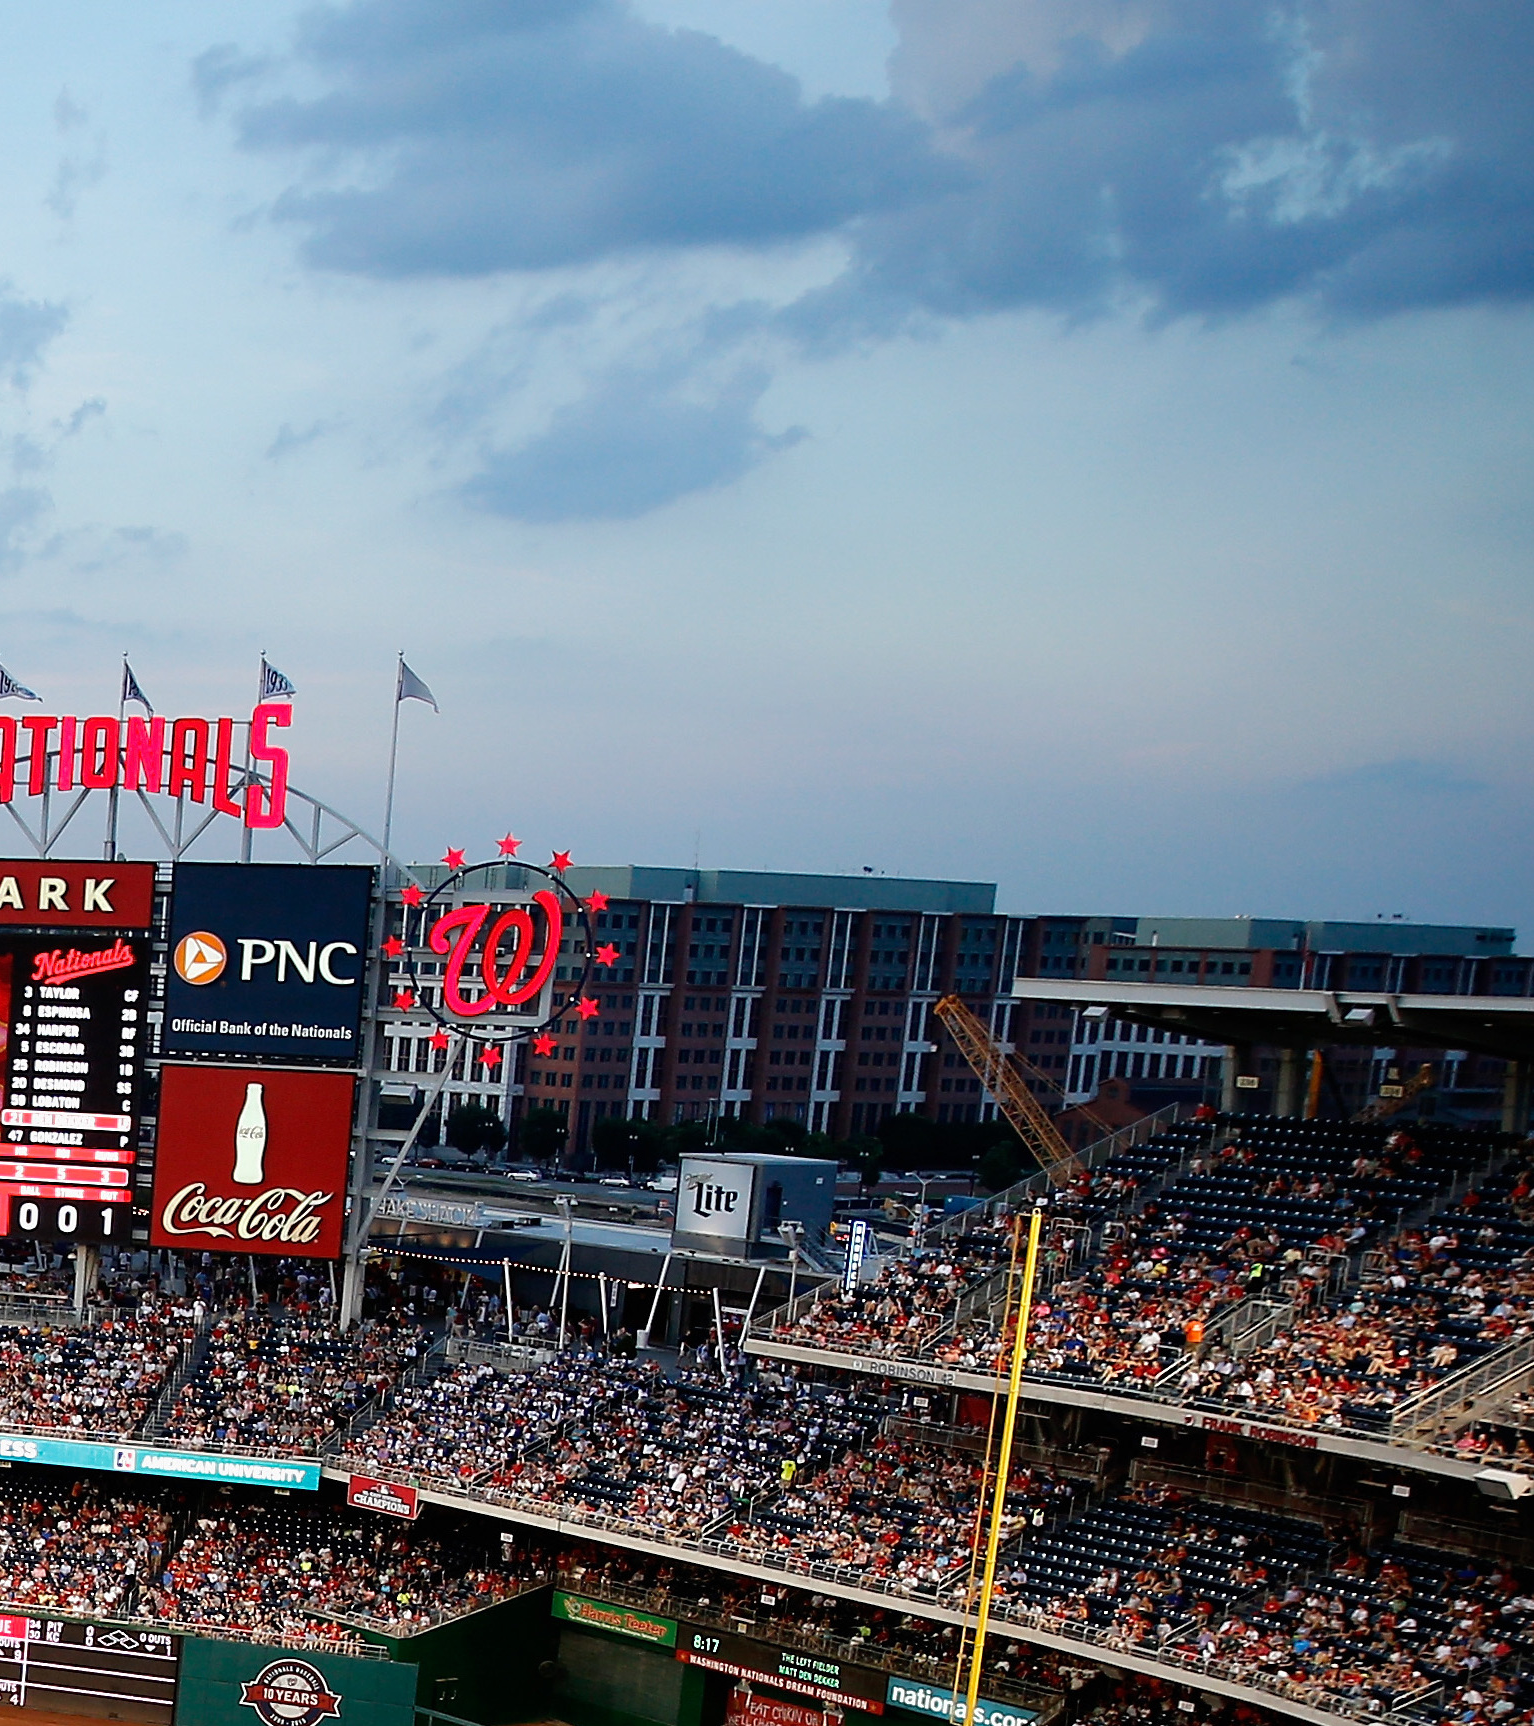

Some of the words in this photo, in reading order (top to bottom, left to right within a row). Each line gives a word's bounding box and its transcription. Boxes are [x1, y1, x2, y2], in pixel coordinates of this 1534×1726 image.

[31, 938, 134, 985] Nationals
[237, 939, 357, 984] PNC
[40, 987, 80, 1000] TAYLOR
[37, 1024, 79, 1037] HARPER
[172, 1019, 216, 1033] Official
[220, 1021, 251, 1034] Bank
[255, 1023, 268, 1035] of
[269, 1024, 288, 1036] the
[291, 1025, 351, 1039] Nationals
[30, 1131, 83, 1146] GONZALEZ
[693, 1182, 737, 1217] Lite
[20, 1203, 38, 1230] 0
[58, 1205, 77, 1232] 0
[102, 1208, 113, 1235] 1
[163, 1183, 333, 1245] Coca-Cola
[871, 1362, 935, 1382] ROBINSON
[1202, 1417, 1244, 1435] FRANK
[1250, 1426, 1318, 1448] ROBINSON
[142, 1455, 216, 1474] AMERICAN
[218, 1461, 305, 1483] UNIVERSITY
[354, 1494, 410, 1515] CHAMPIONS
[581, 1603, 621, 1627] Harris
[624, 1612, 667, 1638] Teeter
[693, 1635, 719, 1653] 8:17
[779, 1665, 797, 1677] MATT
[782, 1652, 795, 1665] THE
[796, 1656, 812, 1669] LEFT
[813, 1661, 839, 1676] FIELDER
[690, 1654, 739, 1676] WASHINGTON
[741, 1669, 784, 1687] NATIONALS
[786, 1680, 814, 1696] DREAM
[816, 1689, 867, 1710] FOUNDATION
[264, 1688, 274, 1699] 10
[276, 1690, 318, 1705] YEARS
[750, 1703, 770, 1718] EAT
